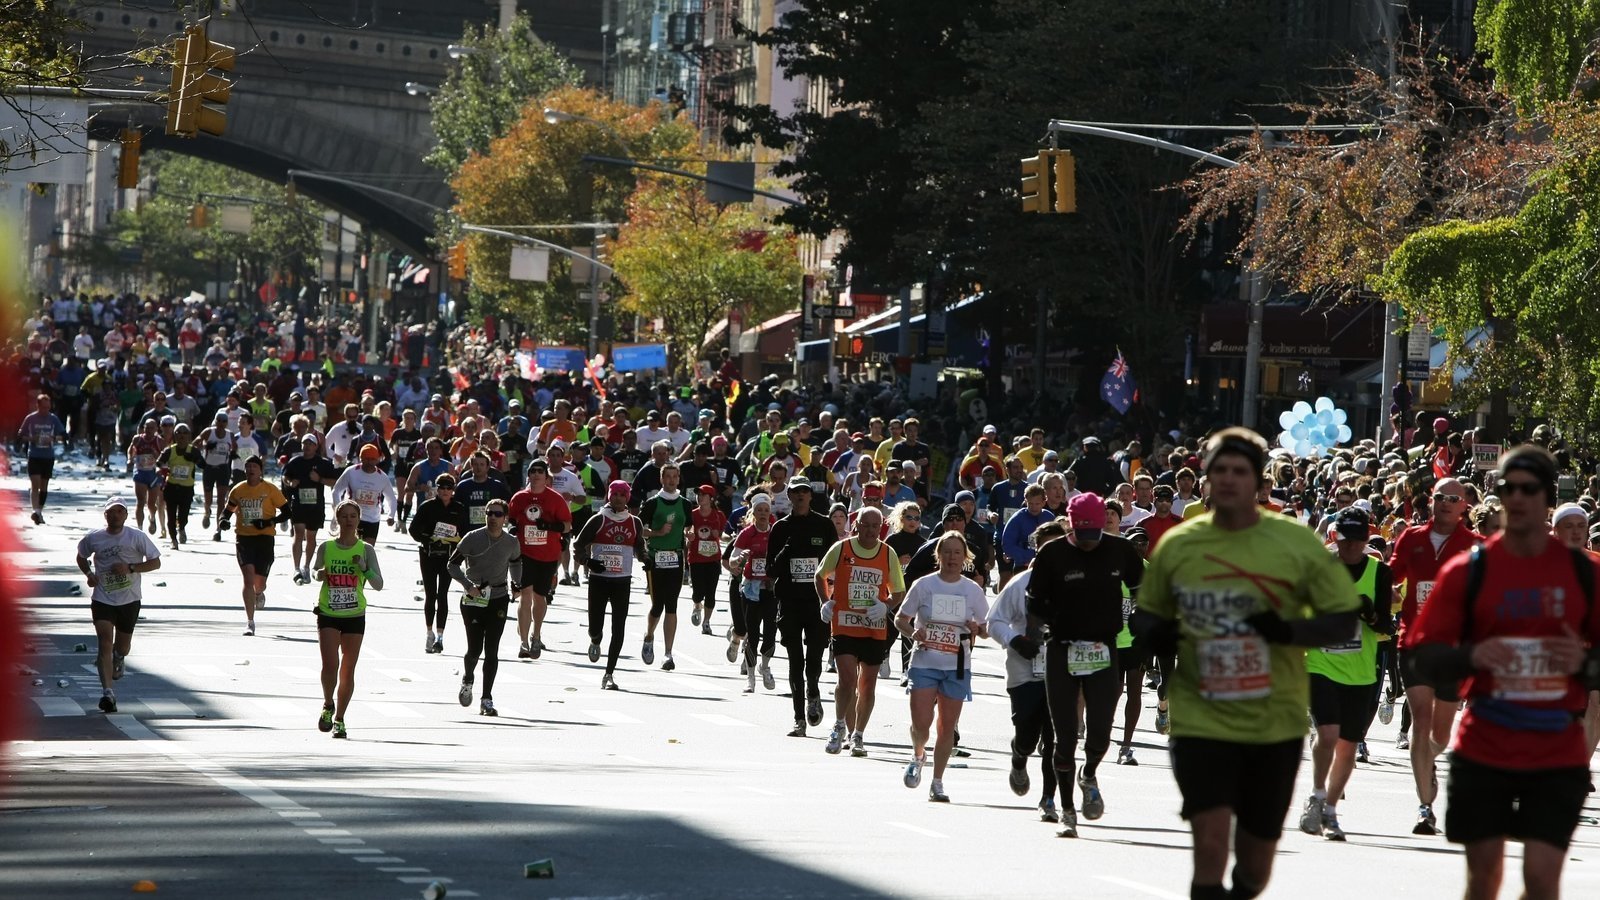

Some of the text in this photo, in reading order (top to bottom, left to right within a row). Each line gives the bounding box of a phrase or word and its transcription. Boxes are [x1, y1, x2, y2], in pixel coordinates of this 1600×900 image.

[1475, 453, 1498, 462] TEAM
[605, 525, 633, 539] ITALIA
[794, 564, 816, 572] 25-234
[328, 574, 358, 587] KELLY
[853, 569, 881, 584] MERV
[332, 594, 355, 603] 22-345
[935, 599, 963, 616] SUE
[928, 630, 956, 645] 15-253
